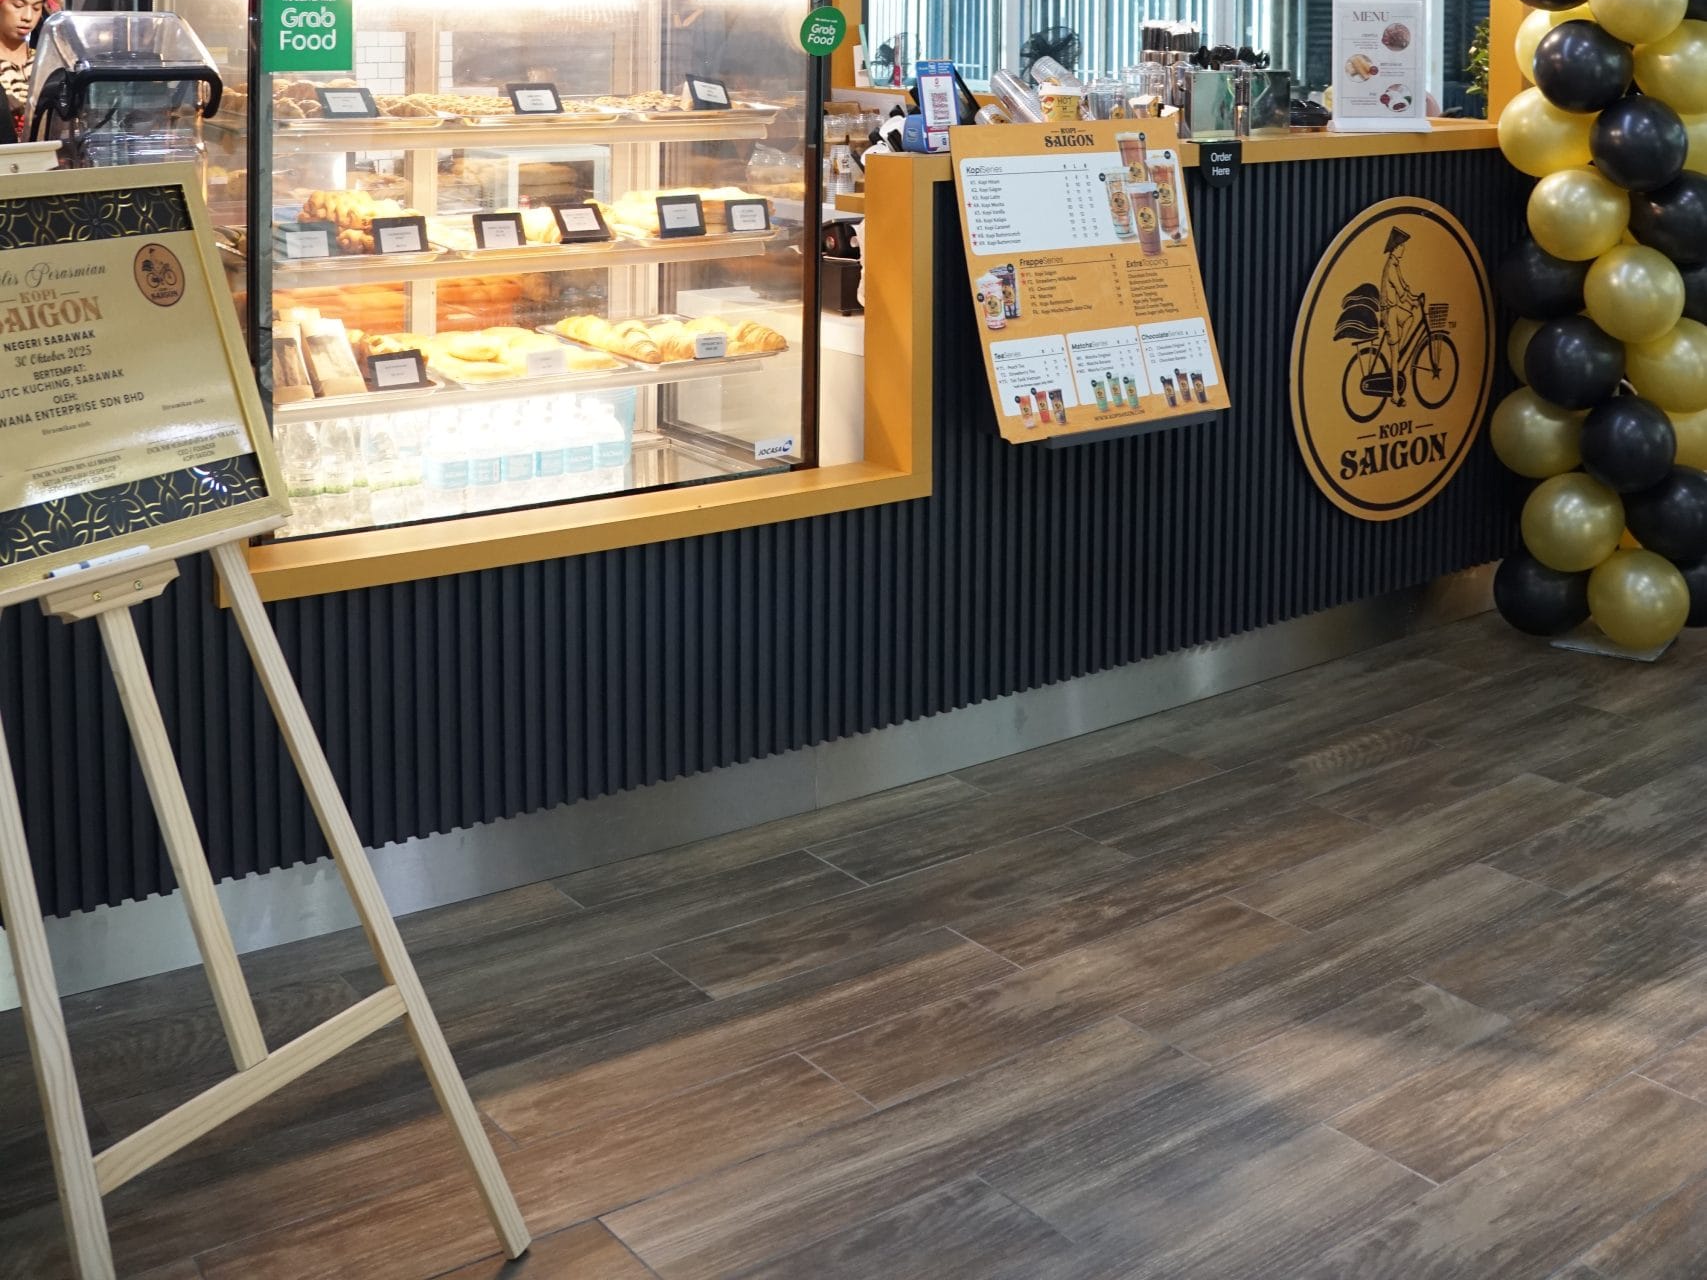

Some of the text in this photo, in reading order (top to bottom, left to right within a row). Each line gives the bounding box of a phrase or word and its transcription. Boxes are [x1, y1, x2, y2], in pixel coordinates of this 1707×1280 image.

[281, 6, 336, 28] Grab
[1352, 11, 1390, 23] MENU
[811, 24, 836, 35] Grab
[279, 29, 337, 51] Food
[807, 33, 835, 45] Food
[1044, 134, 1095, 148] SAIGON
[1210, 152, 1232, 163] Order
[1211, 166, 1230, 176] Here
[25, 262, 106, 288] Perasmian
[19, 289, 57, 303] KOPI
[3, 330, 96, 352] NEGERI SARAWAK
[30, 350, 66, 365] Oktober
[67, 345, 92, 359] 2025
[33, 363, 86, 380] BERTEMPAT:
[22, 379, 74, 395] KUCHING,
[76, 369, 124, 385] SARAWAK
[53, 392, 79, 404] OLEH:
[0, 391, 144, 428] WANA ENTERPRISE SDN BHD
[1379, 420, 1412, 439] KOPI
[1340, 432, 1448, 480] SAIGON
